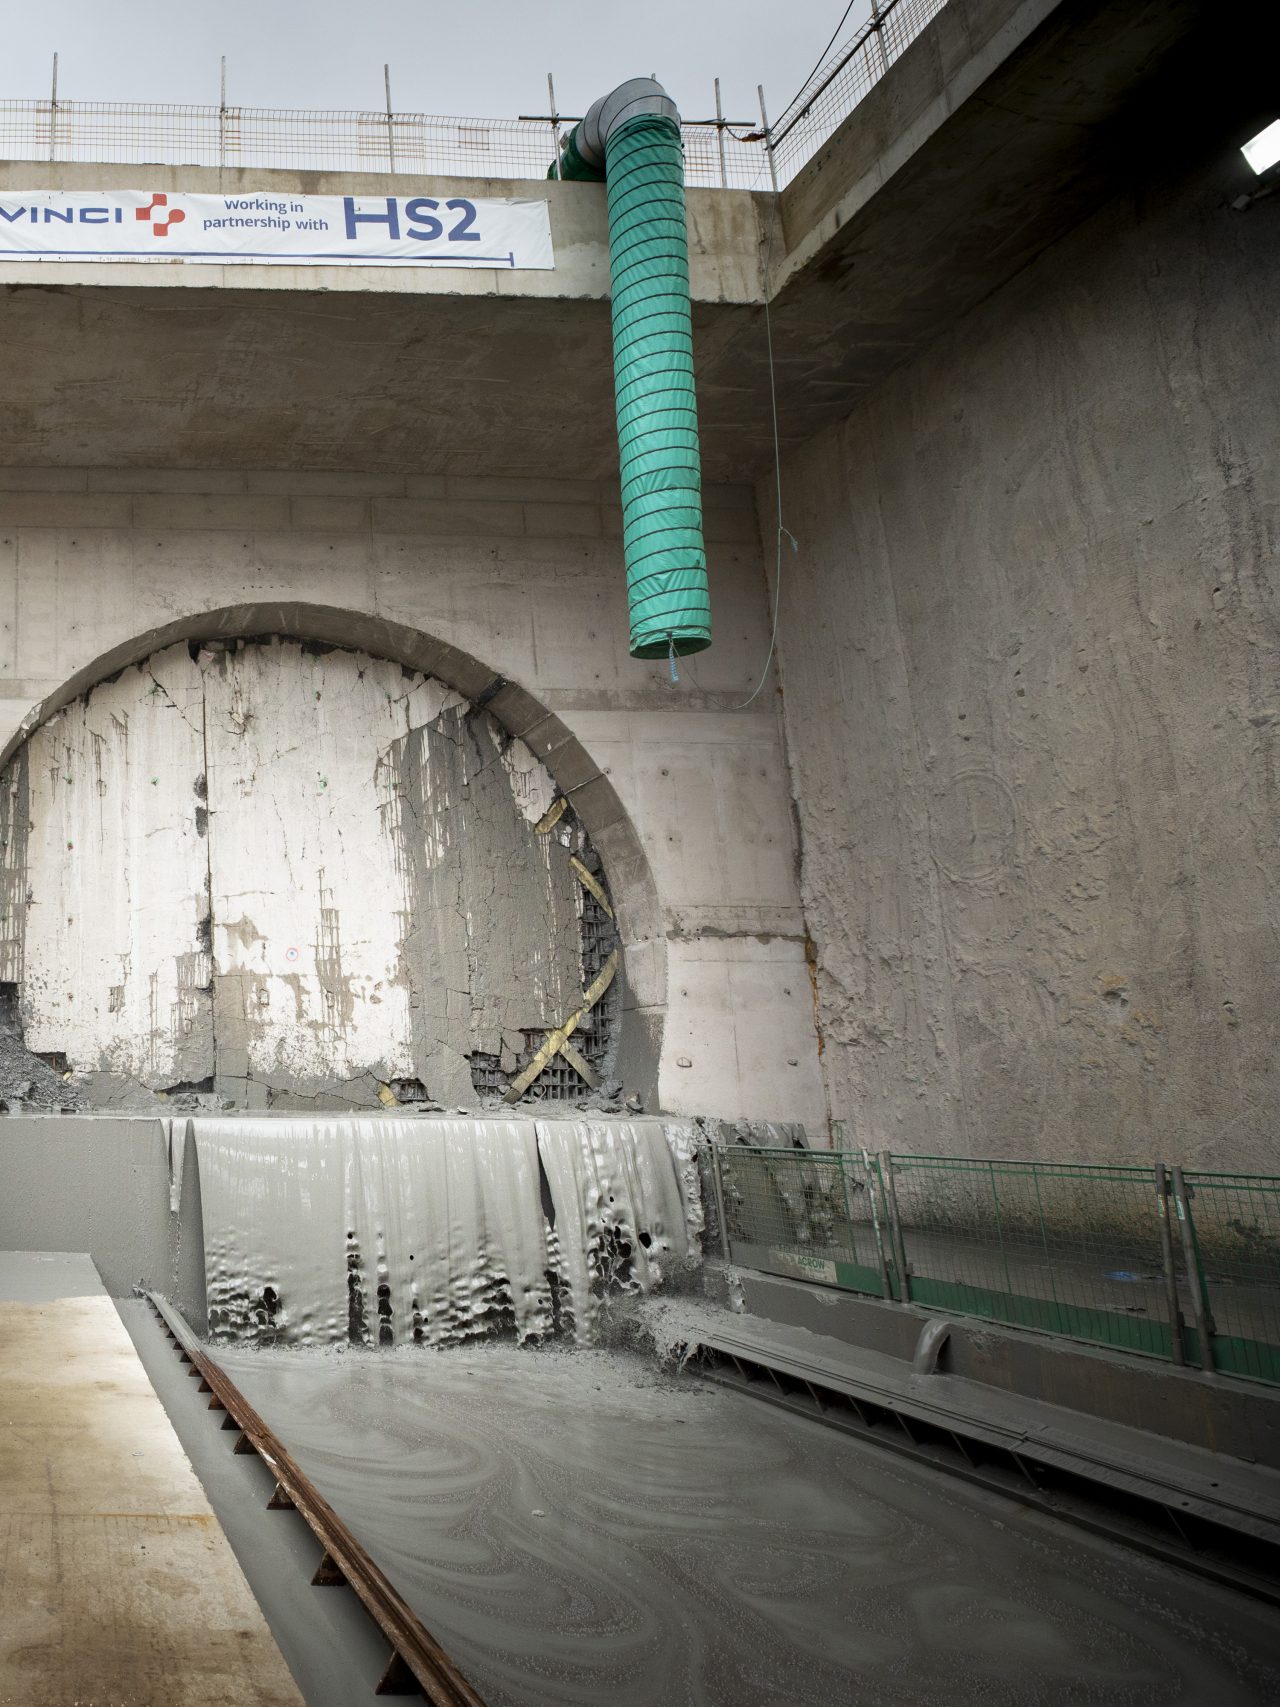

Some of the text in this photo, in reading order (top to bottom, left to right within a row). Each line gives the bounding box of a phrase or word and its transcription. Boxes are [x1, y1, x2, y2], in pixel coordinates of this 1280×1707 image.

[224, 199, 304, 214] Working in
[202, 216, 329, 232] partnership with
[343, 197, 481, 241] HS2
